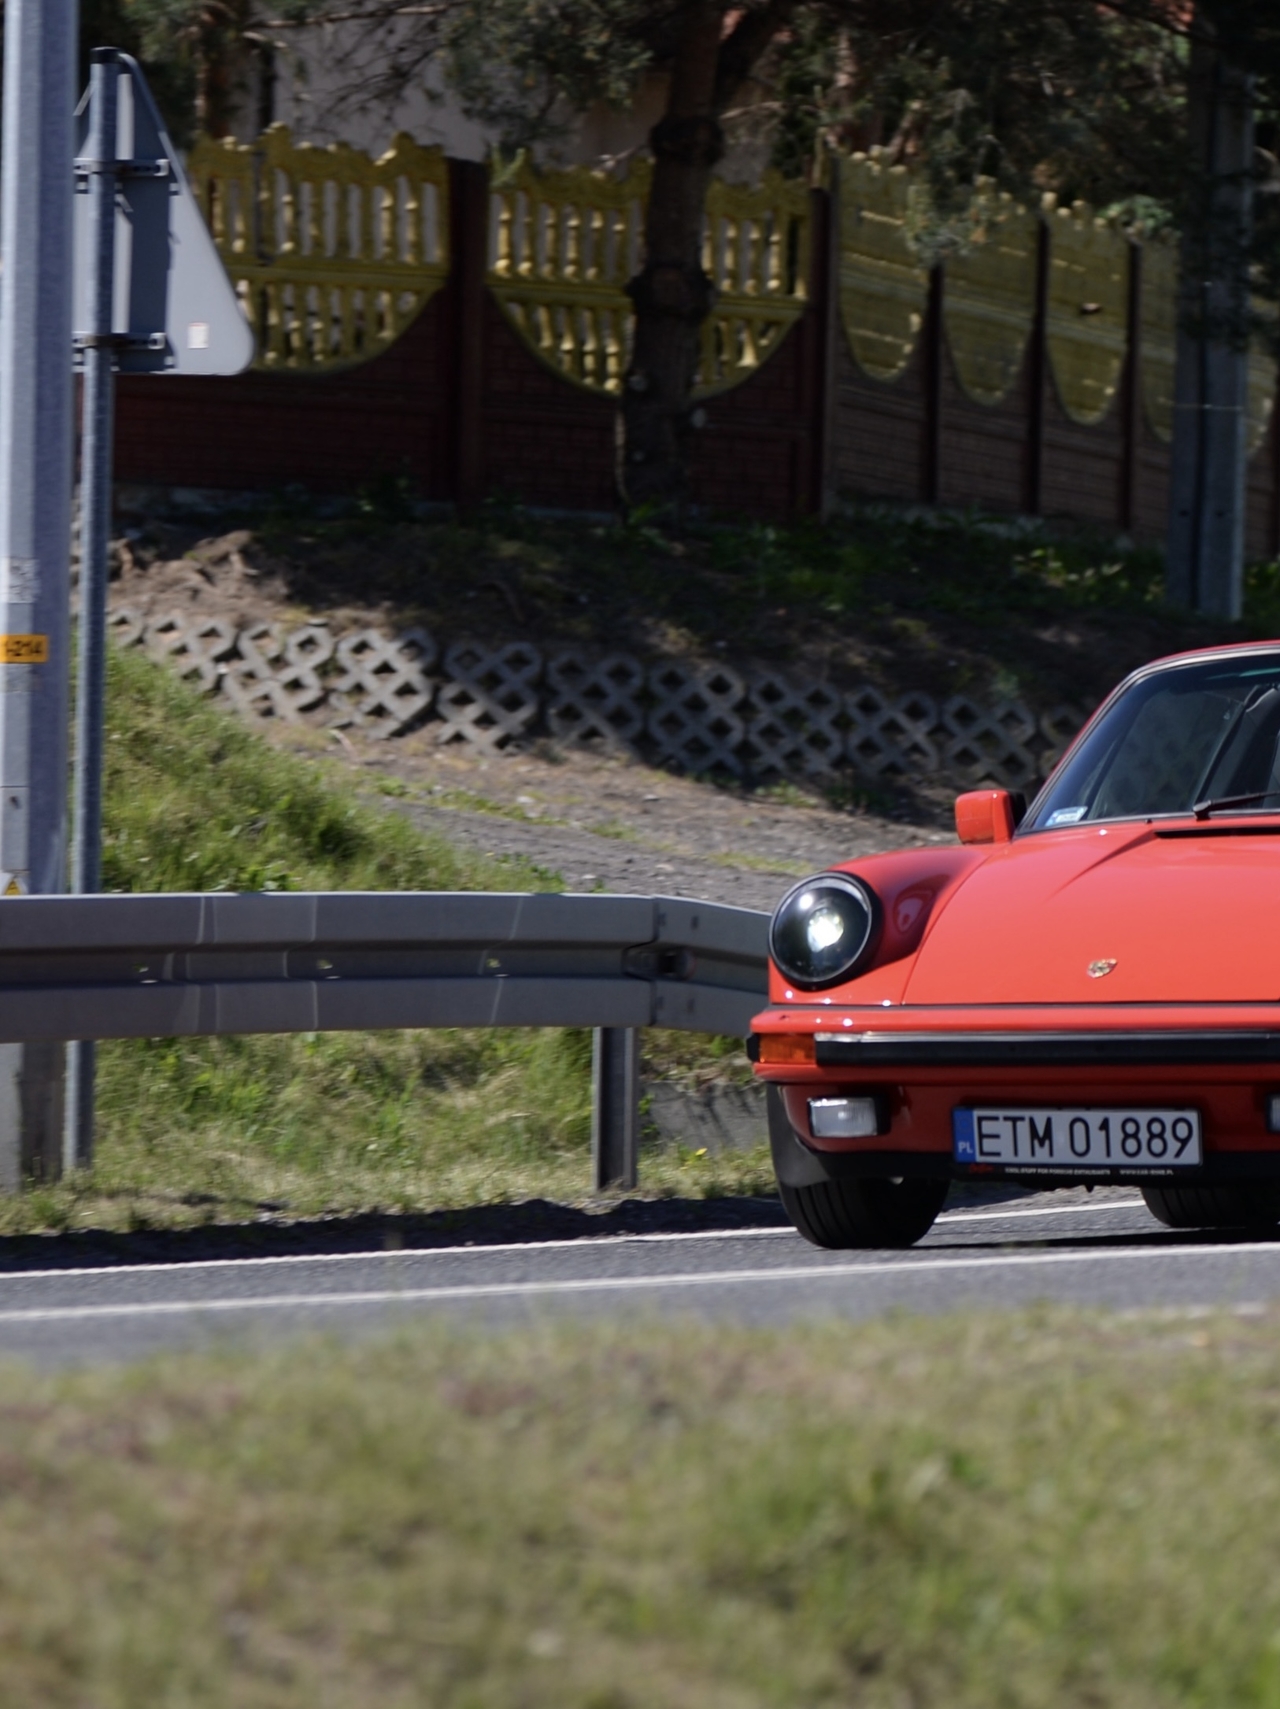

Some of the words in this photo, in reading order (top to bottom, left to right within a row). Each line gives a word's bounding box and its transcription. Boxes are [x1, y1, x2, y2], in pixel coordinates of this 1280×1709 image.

[958, 1141, 974, 1154] PL
[976, 1115, 1055, 1158] ETM
[1068, 1116, 1194, 1159] 01889
